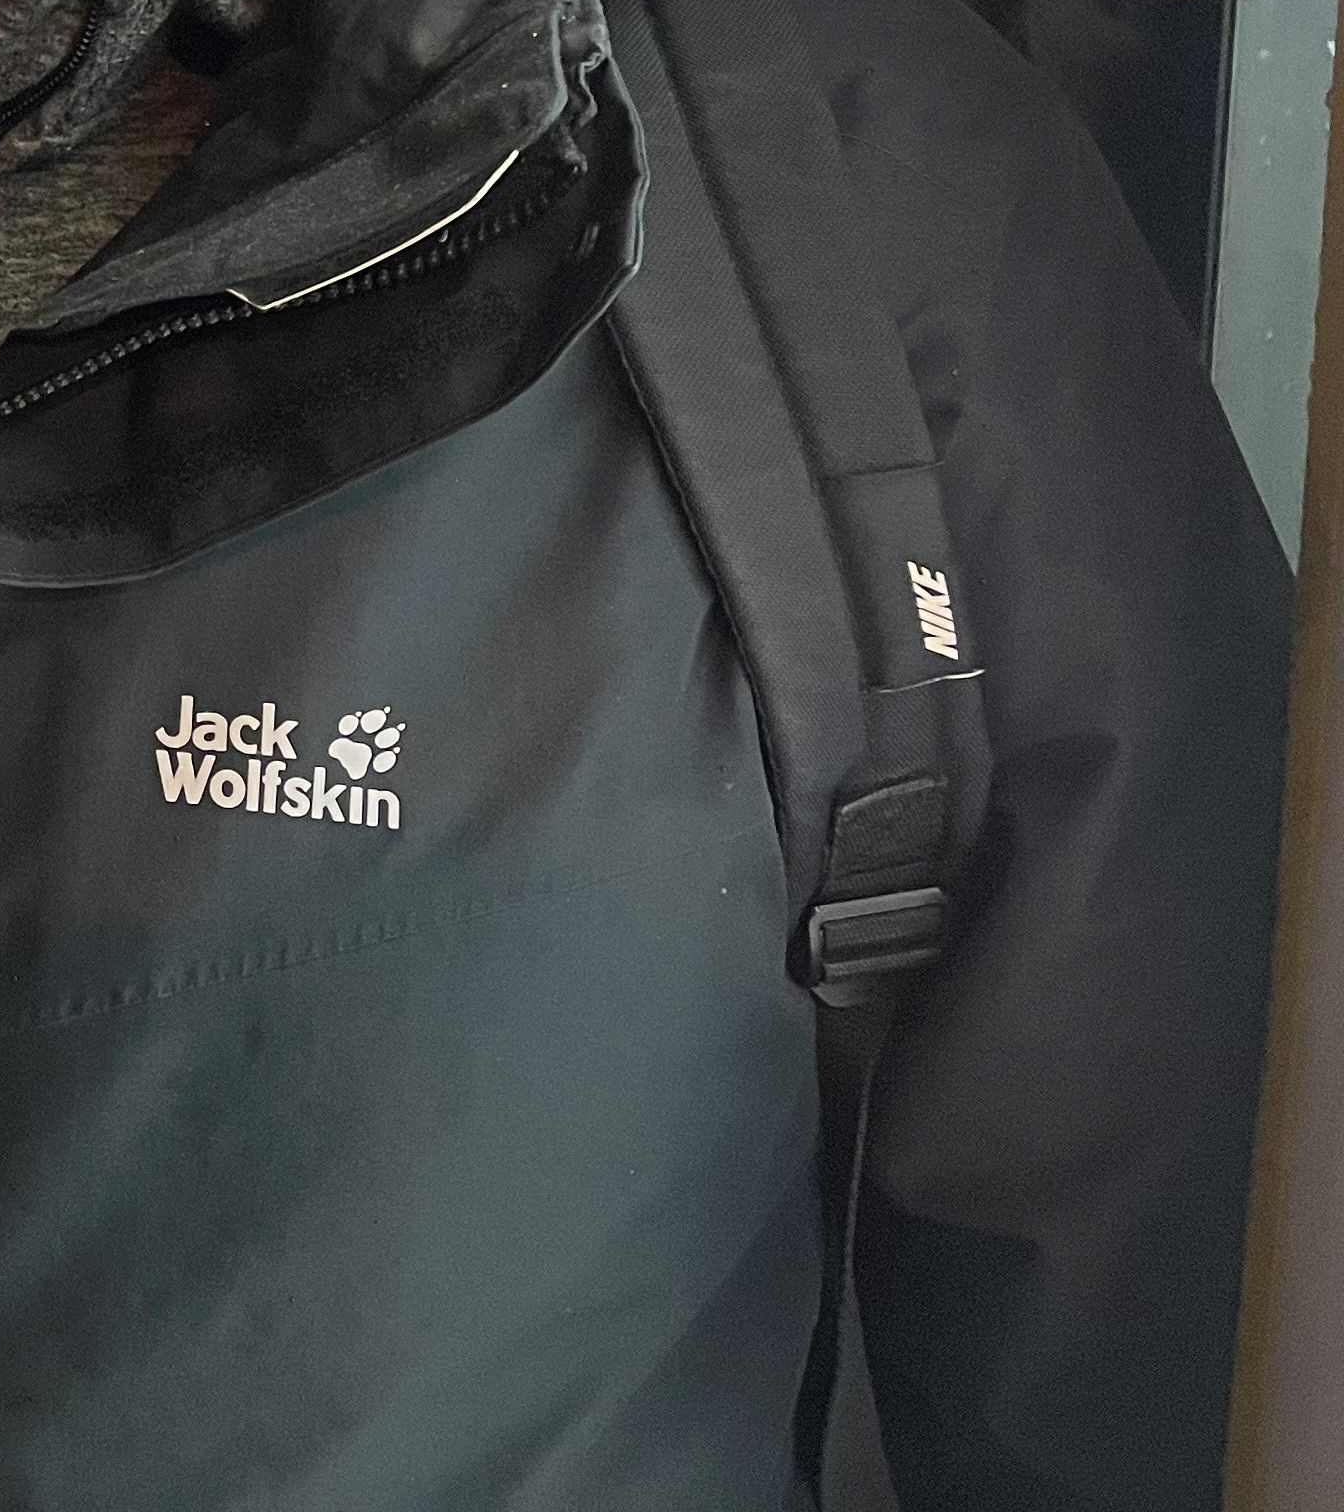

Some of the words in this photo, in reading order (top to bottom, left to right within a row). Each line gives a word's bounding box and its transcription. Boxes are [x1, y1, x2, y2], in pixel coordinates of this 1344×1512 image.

[906, 560, 959, 661] NIKE
[155, 694, 299, 760] Jack
[155, 749, 401, 830] Wolfskin
